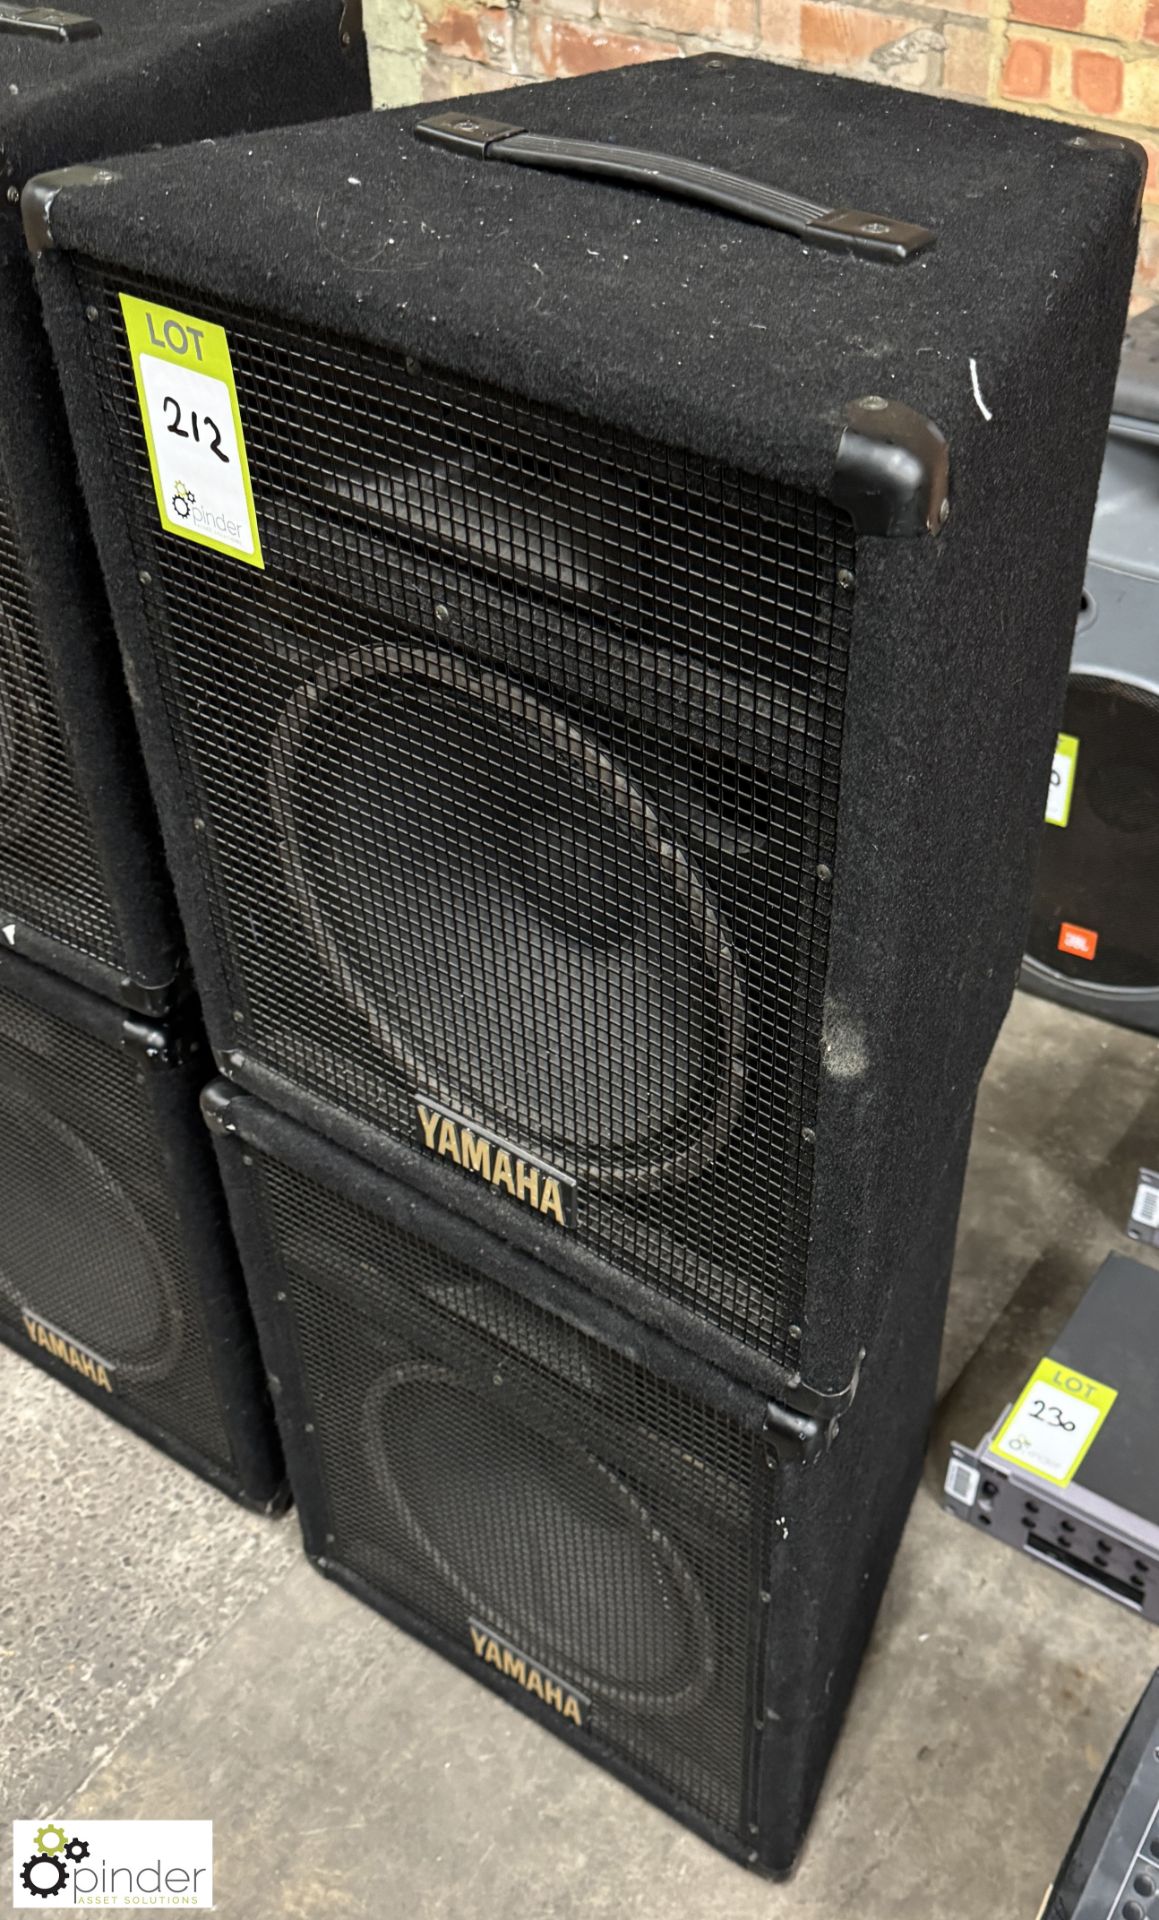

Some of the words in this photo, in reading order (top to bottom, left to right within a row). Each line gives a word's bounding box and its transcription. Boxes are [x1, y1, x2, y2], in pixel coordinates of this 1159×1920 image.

[145, 312, 204, 361] LOT
[163, 396, 229, 463] 212
[192, 505, 242, 538] pinder
[417, 1104, 567, 1227] YAMAHA
[22, 1315, 113, 1393] YAMAHA
[1053, 1370, 1097, 1399] LOT
[1028, 1400, 1076, 1432] 230
[469, 1625, 582, 1726] YAMAHA
